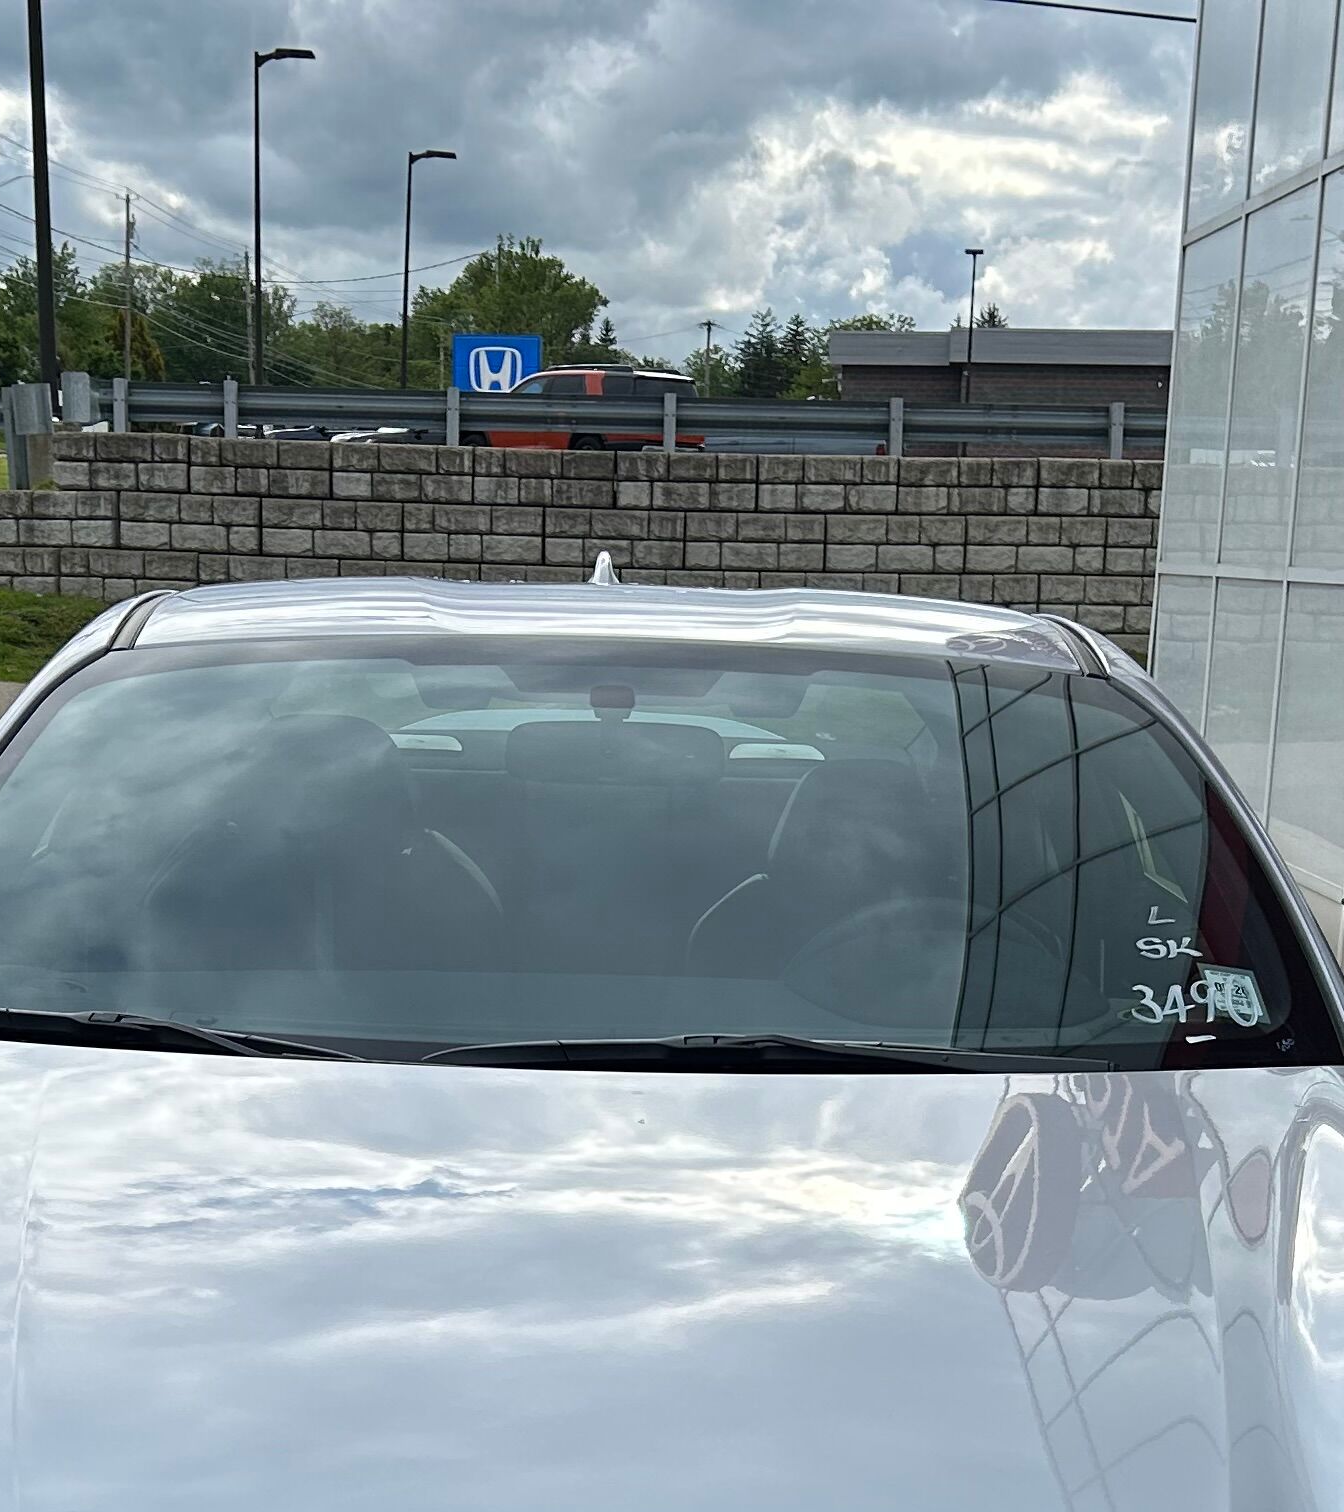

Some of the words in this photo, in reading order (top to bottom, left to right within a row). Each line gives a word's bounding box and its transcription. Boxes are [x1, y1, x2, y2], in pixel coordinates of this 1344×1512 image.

[1148, 906, 1176, 925] L
[1136, 936, 1203, 959] SK
[1131, 976, 1258, 1027] 3490
